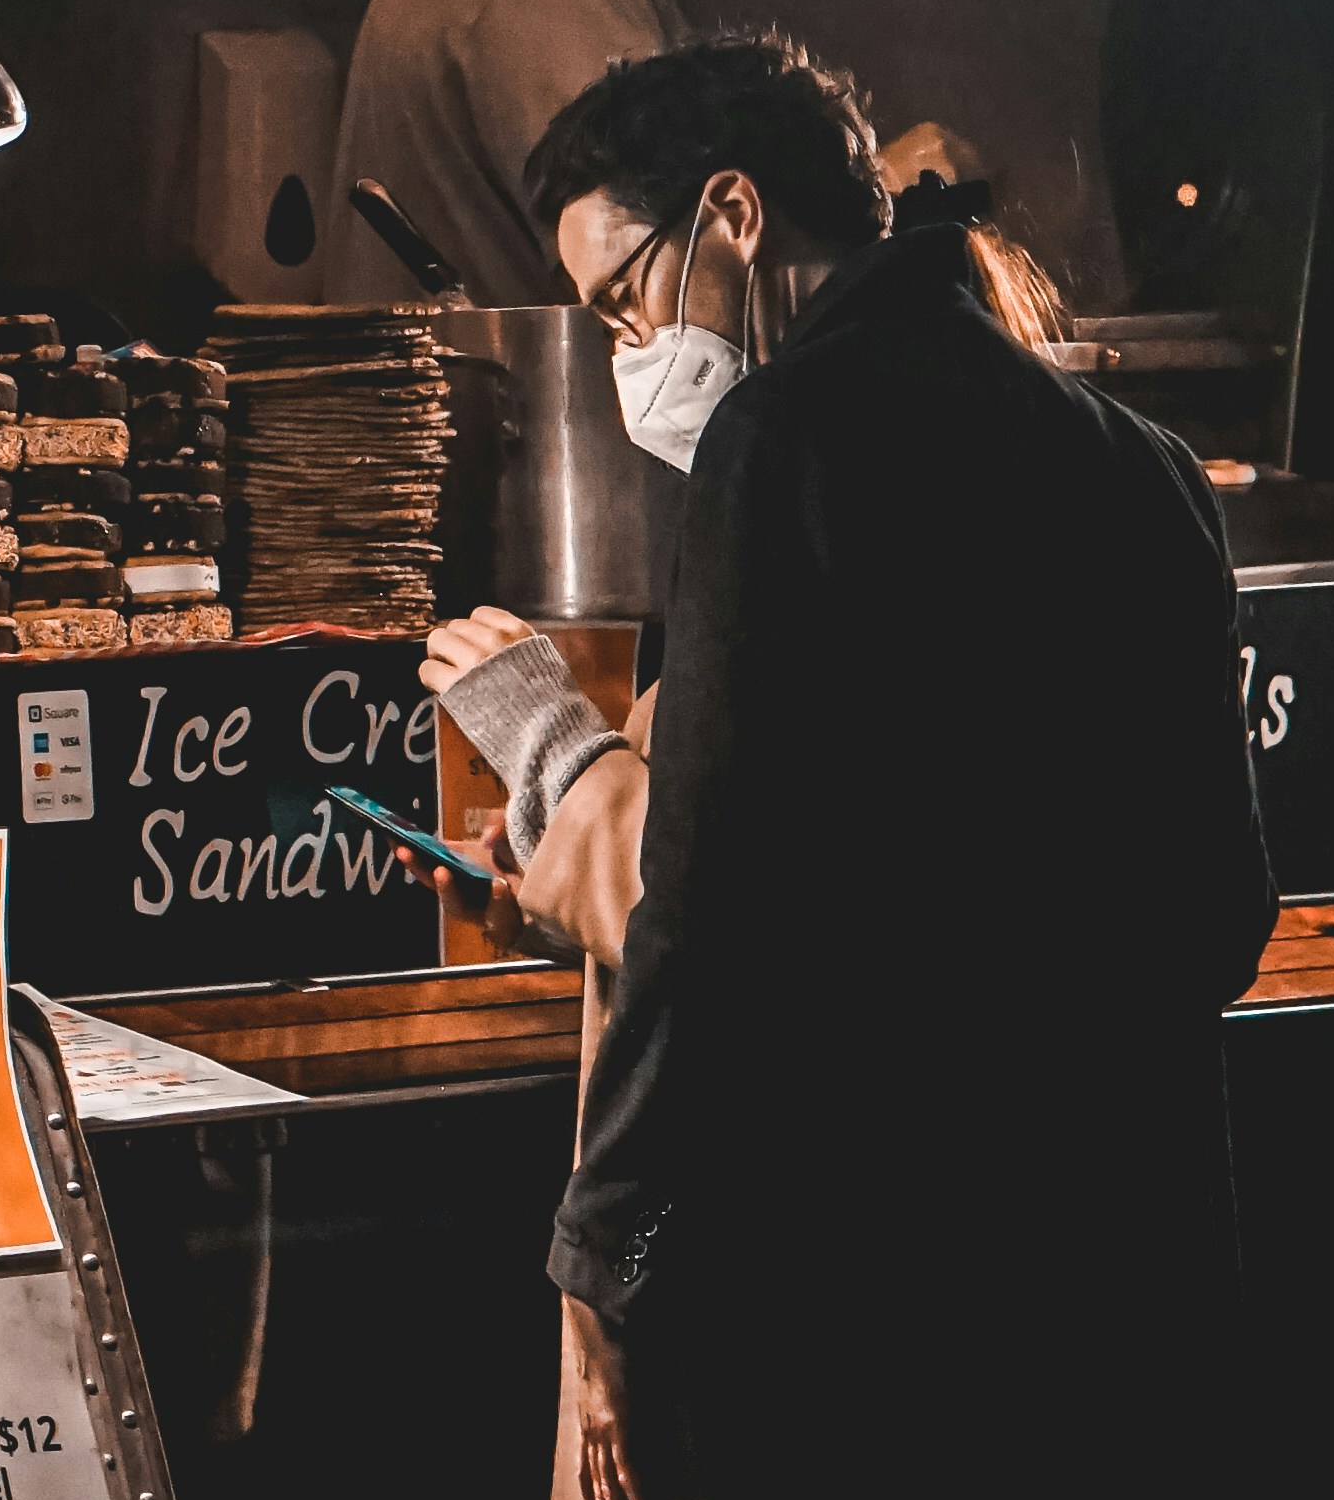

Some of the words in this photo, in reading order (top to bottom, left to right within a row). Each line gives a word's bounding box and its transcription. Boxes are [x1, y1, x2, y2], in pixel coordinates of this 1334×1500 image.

[43, 706, 79, 720] Square
[59, 736, 81, 747] VISA
[127, 686, 252, 787] Ice
[133, 796, 419, 917] Sandw
